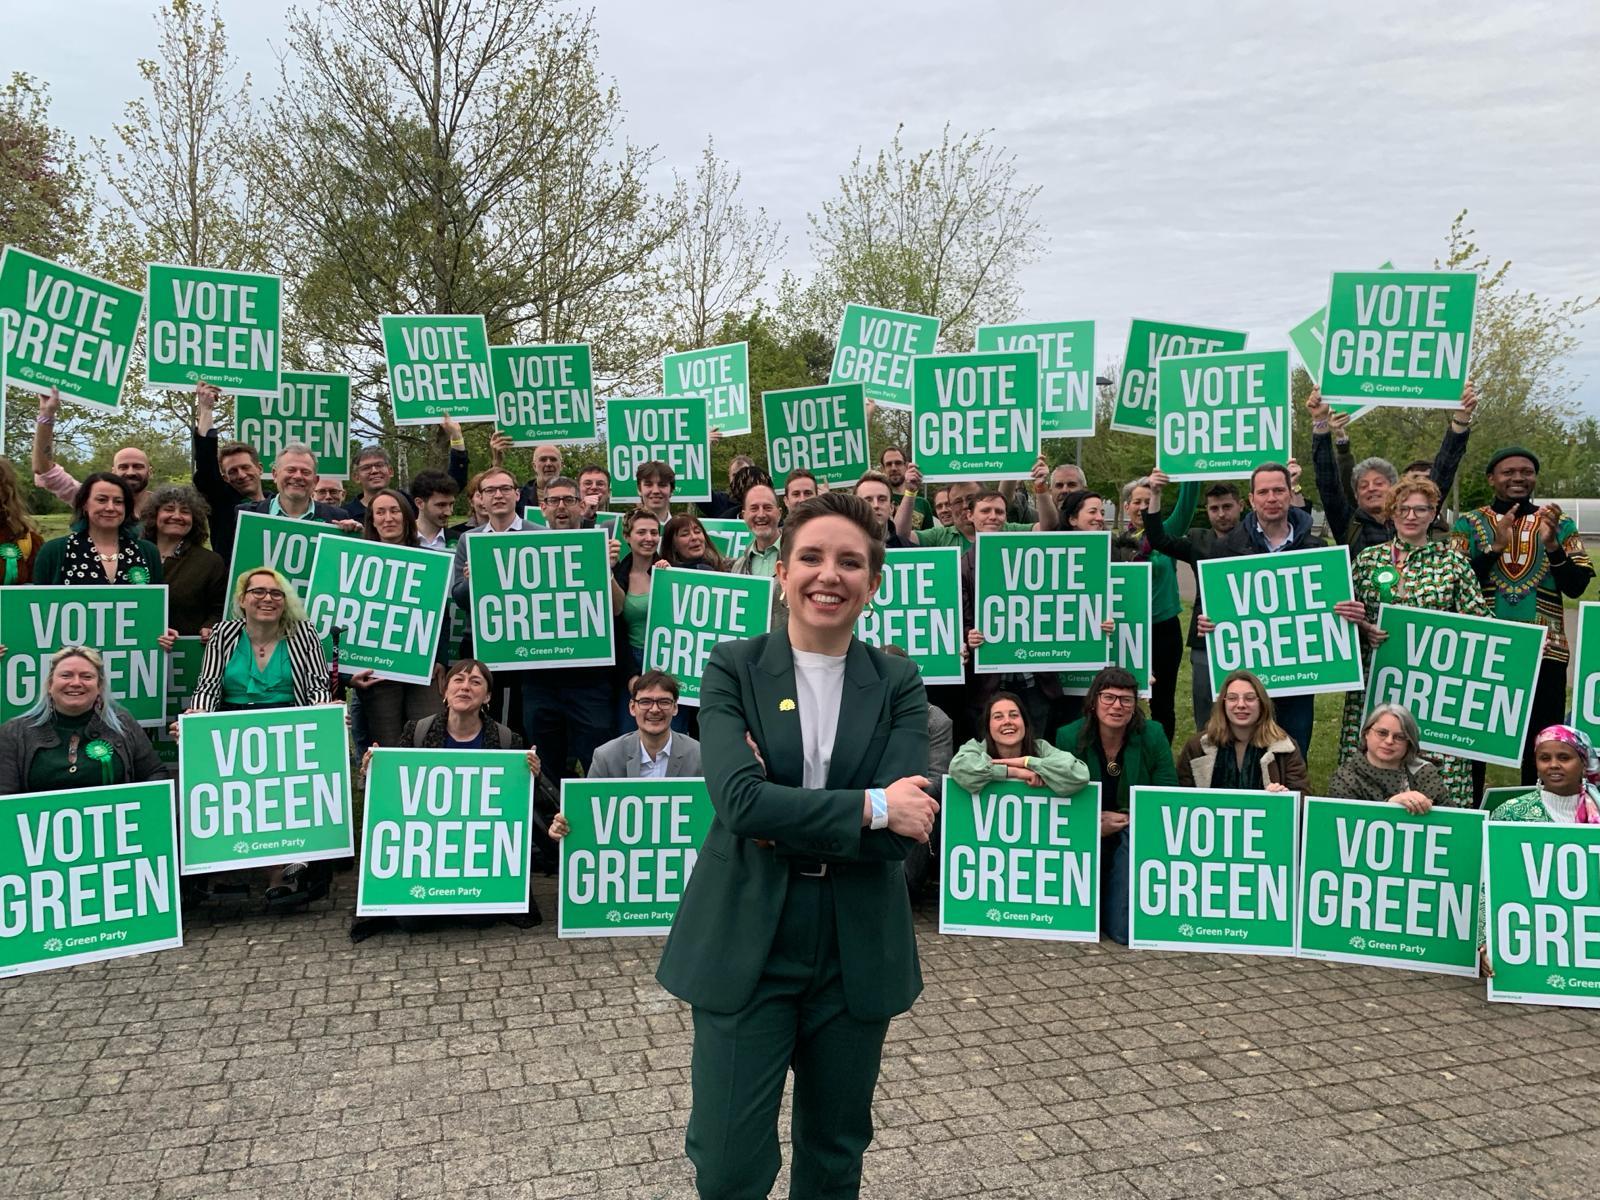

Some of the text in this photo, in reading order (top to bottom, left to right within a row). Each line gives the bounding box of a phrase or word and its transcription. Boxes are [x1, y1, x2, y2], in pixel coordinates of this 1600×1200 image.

[26, 269, 119, 336] VOTE
[171, 278, 259, 325] VOTE
[1355, 284, 1450, 328] VOTE
[153, 320, 274, 371] GREEN
[401, 327, 472, 360] VOTE
[859, 316, 922, 354] VOTE
[1328, 328, 1465, 379] GREEN
[35, 372, 82, 392] Green Party
[200, 373, 243, 384] Green Party
[393, 361, 491, 402] GREEN
[507, 355, 575, 388] VOTE
[678, 354, 733, 389] VOTE
[934, 364, 1016, 408] VOTE
[1180, 364, 1265, 408] VOTE
[1375, 384, 1423, 395] Green Party
[436, 405, 469, 414] Green Party
[499, 388, 591, 426] GREEN
[624, 408, 690, 442] VOTE
[781, 395, 849, 433] VOTE
[552, 429, 568, 437] Party
[772, 428, 864, 473] GREEN
[918, 408, 1033, 457] GREEN
[1163, 406, 1283, 456] GREEN
[962, 460, 1003, 470] Green Party
[1208, 458, 1252, 468] Green Party
[339, 551, 427, 604] VOTE
[493, 545, 585, 591] VOTE
[873, 562, 936, 606] OTE
[1001, 547, 1086, 591] VOTE
[1226, 564, 1327, 616] VOTE
[29, 601, 138, 648] VOTE
[309, 594, 435, 656] GREEN
[478, 590, 605, 643] GREEN
[671, 582, 749, 632] VOTE
[983, 594, 1102, 643] GREEN
[529, 646, 575, 657] Green Party
[857, 608, 955, 656] REEN
[1028, 649, 1071, 659] Green Party
[1214, 612, 1352, 670] GREEN
[1406, 623, 1512, 681] VOTE
[6, 650, 158, 706] GEN
[350, 652, 394, 667] Green Party
[1270, 671, 1319, 683] Green Party
[1374, 666, 1525, 737] GREEN
[211, 722, 320, 778] VOTE
[1424, 728, 1475, 746] Green Party
[189, 772, 343, 839] GREEN
[399, 766, 505, 816] VOTE
[16, 801, 143, 867] VOTE
[591, 795, 693, 845] VOTE
[971, 794, 1072, 846] VOTE
[1160, 805, 1266, 859] VOTE
[251, 837, 306, 850] Green Party
[370, 820, 522, 880] GREEN
[1336, 817, 1452, 877] VOTE
[0, 855, 170, 938] GREEN
[428, 886, 482, 899] Green Party
[949, 845, 1091, 907] GREEN
[1139, 859, 1287, 921] GREEN
[623, 911, 674, 921] Green Party
[1003, 912, 1054, 924] Green Party
[1308, 869, 1473, 941] GREEN
[65, 930, 127, 947] Green Party
[1196, 926, 1248, 939] Green Party
[1368, 940, 1426, 956] Green Party
